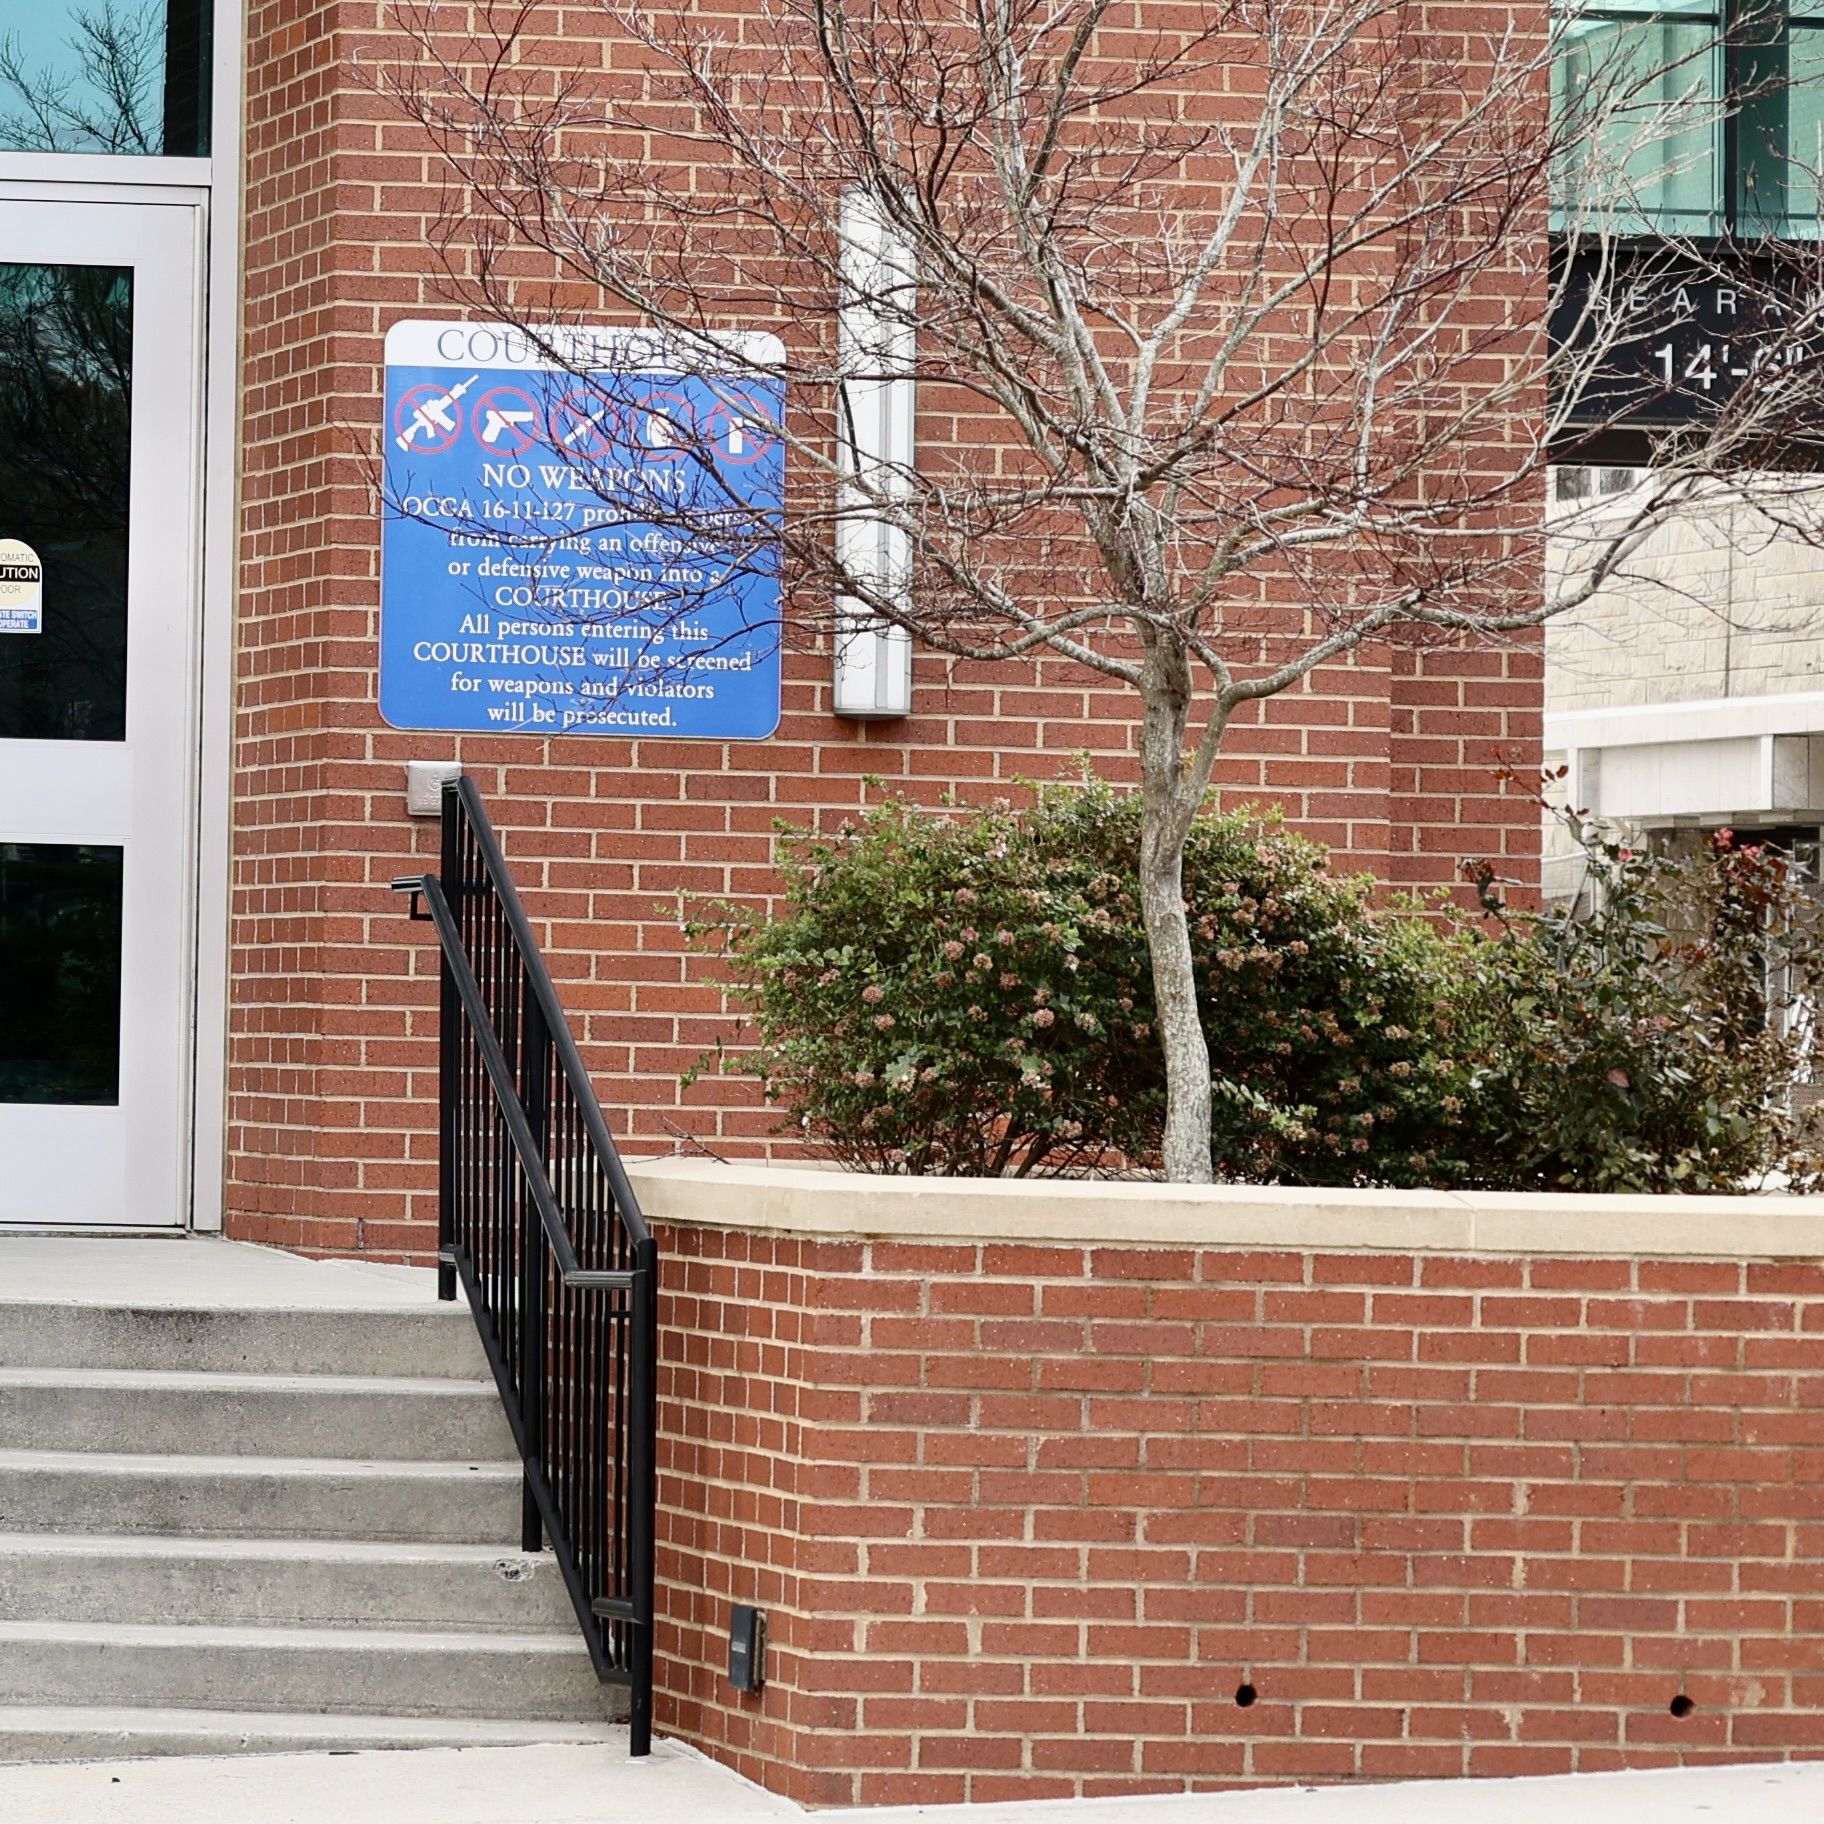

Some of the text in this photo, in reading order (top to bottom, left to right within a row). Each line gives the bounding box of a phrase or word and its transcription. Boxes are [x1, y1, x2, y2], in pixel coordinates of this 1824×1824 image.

[482, 464, 686, 494] NO WEAPONS
[402, 496, 473, 518] OCGA
[482, 499, 576, 521] 16-11-127
[449, 526, 502, 548] from
[599, 538, 622, 553] an
[448, 561, 471, 576] or
[477, 557, 570, 579] defensive
[576, 564, 653, 585] weapon
[459, 614, 709, 645] All persons entering this
[413, 642, 752, 672] COURTHOUSE will be screened
[451, 672, 715, 699] for weapons and violators
[487, 701, 677, 728] will be prosecuted.
